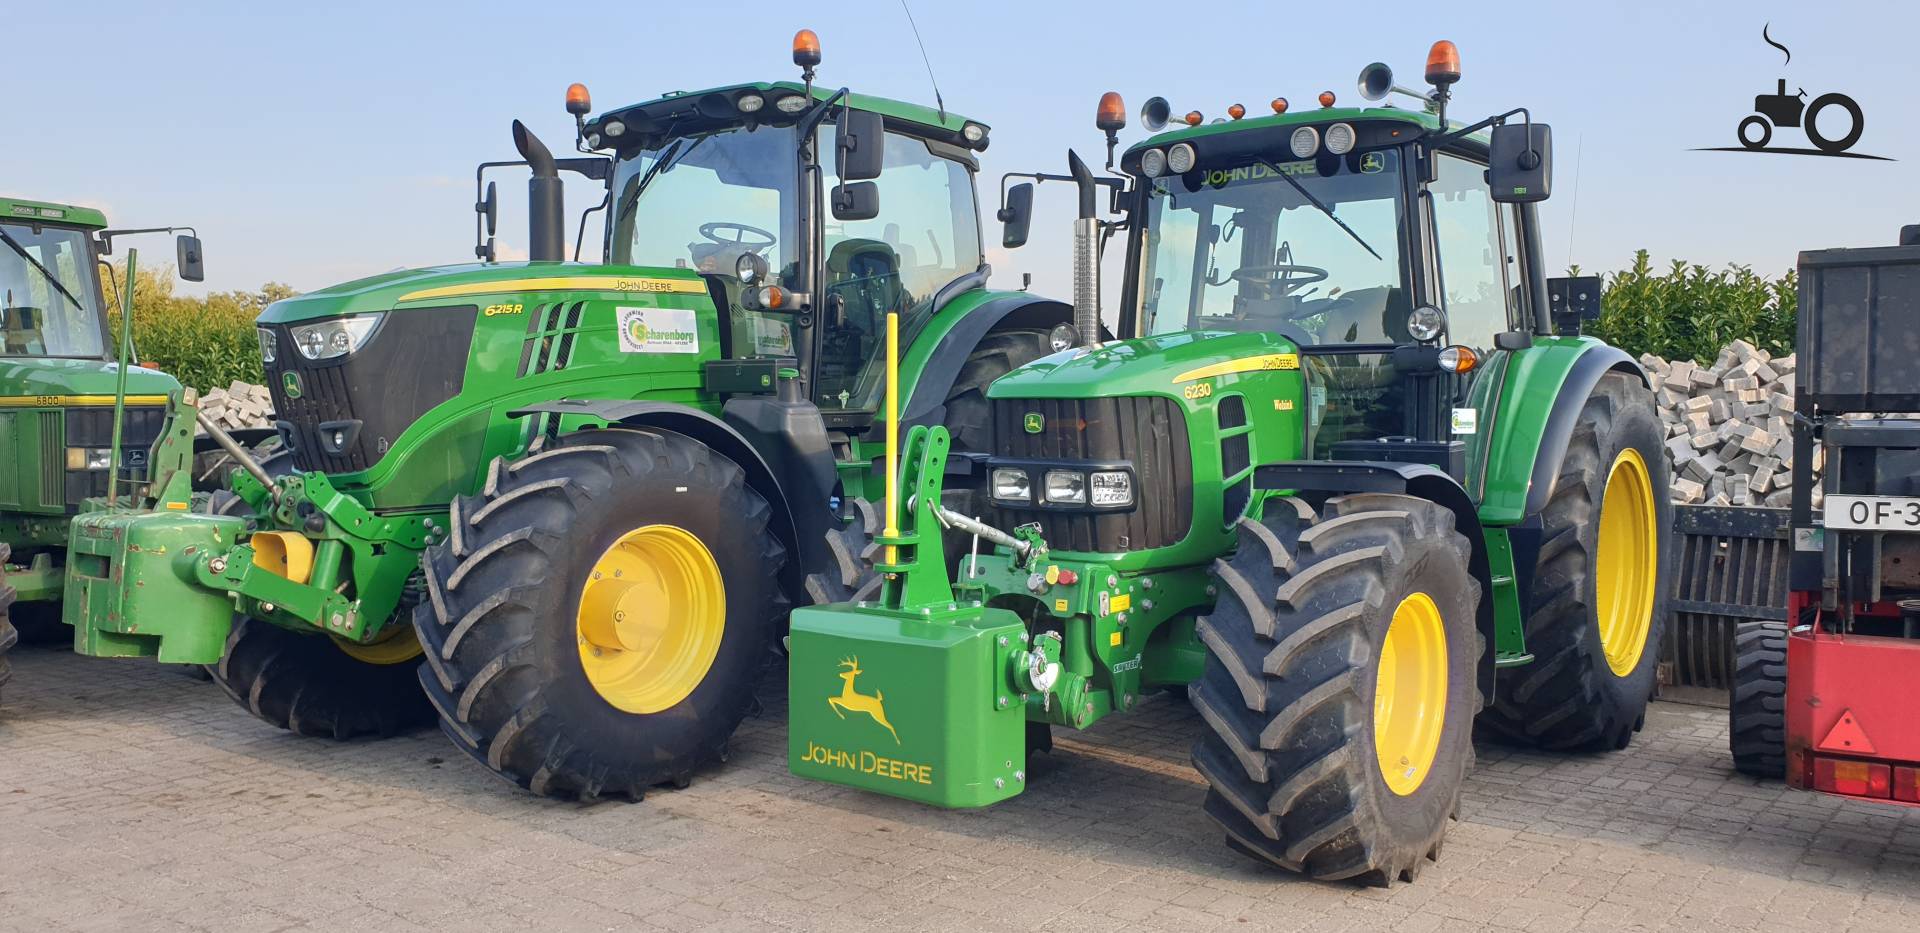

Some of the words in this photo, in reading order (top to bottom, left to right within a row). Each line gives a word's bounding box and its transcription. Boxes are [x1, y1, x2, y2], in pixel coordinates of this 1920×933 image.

[1201, 166, 1249, 185] JOHN
[1252, 162, 1316, 179] DEERE
[615, 279, 641, 290] JOHN
[641, 280, 673, 291] DEERE
[36, 396, 59, 406] 6800
[1184, 382, 1211, 400] 6230
[1849, 500, 1920, 527] OF-3
[801, 740, 857, 771] JOHN
[859, 750, 933, 785] DEERE
